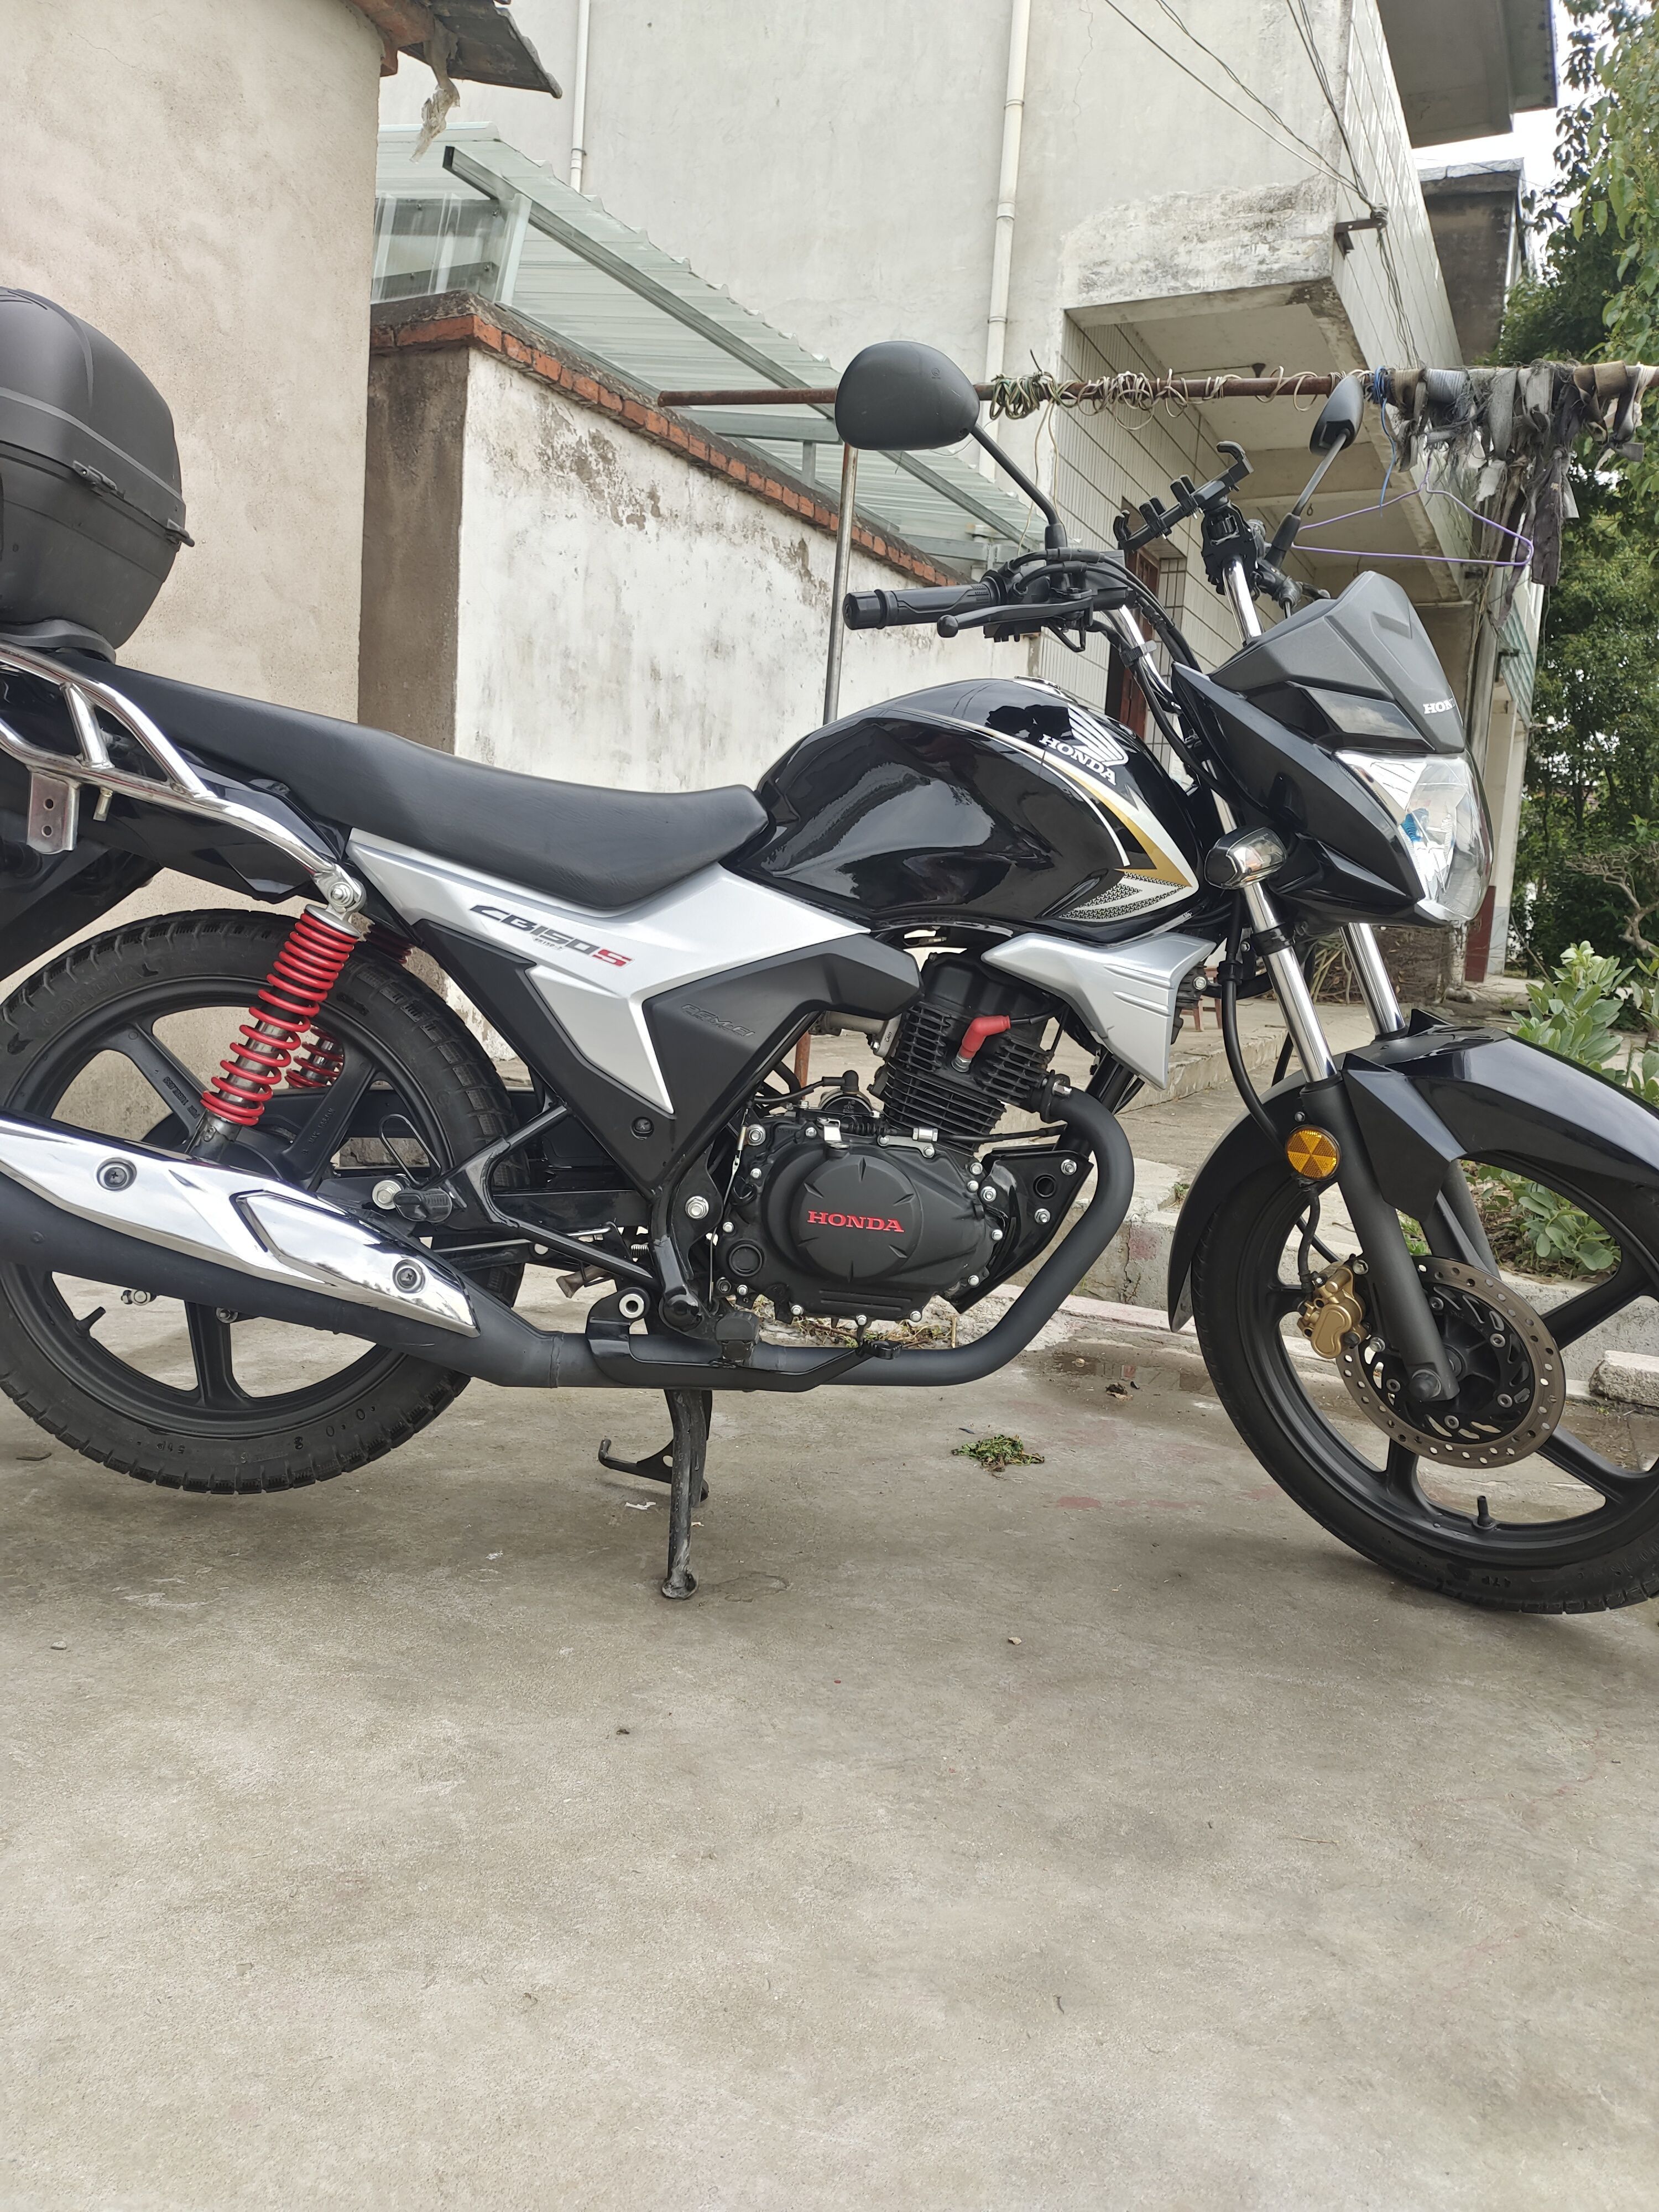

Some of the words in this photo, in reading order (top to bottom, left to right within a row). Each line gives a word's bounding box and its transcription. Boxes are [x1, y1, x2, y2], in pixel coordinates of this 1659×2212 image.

[1039, 734, 1116, 786] HONDA
[469, 905, 634, 968] CB150S
[807, 1210, 905, 1233] HONDA
